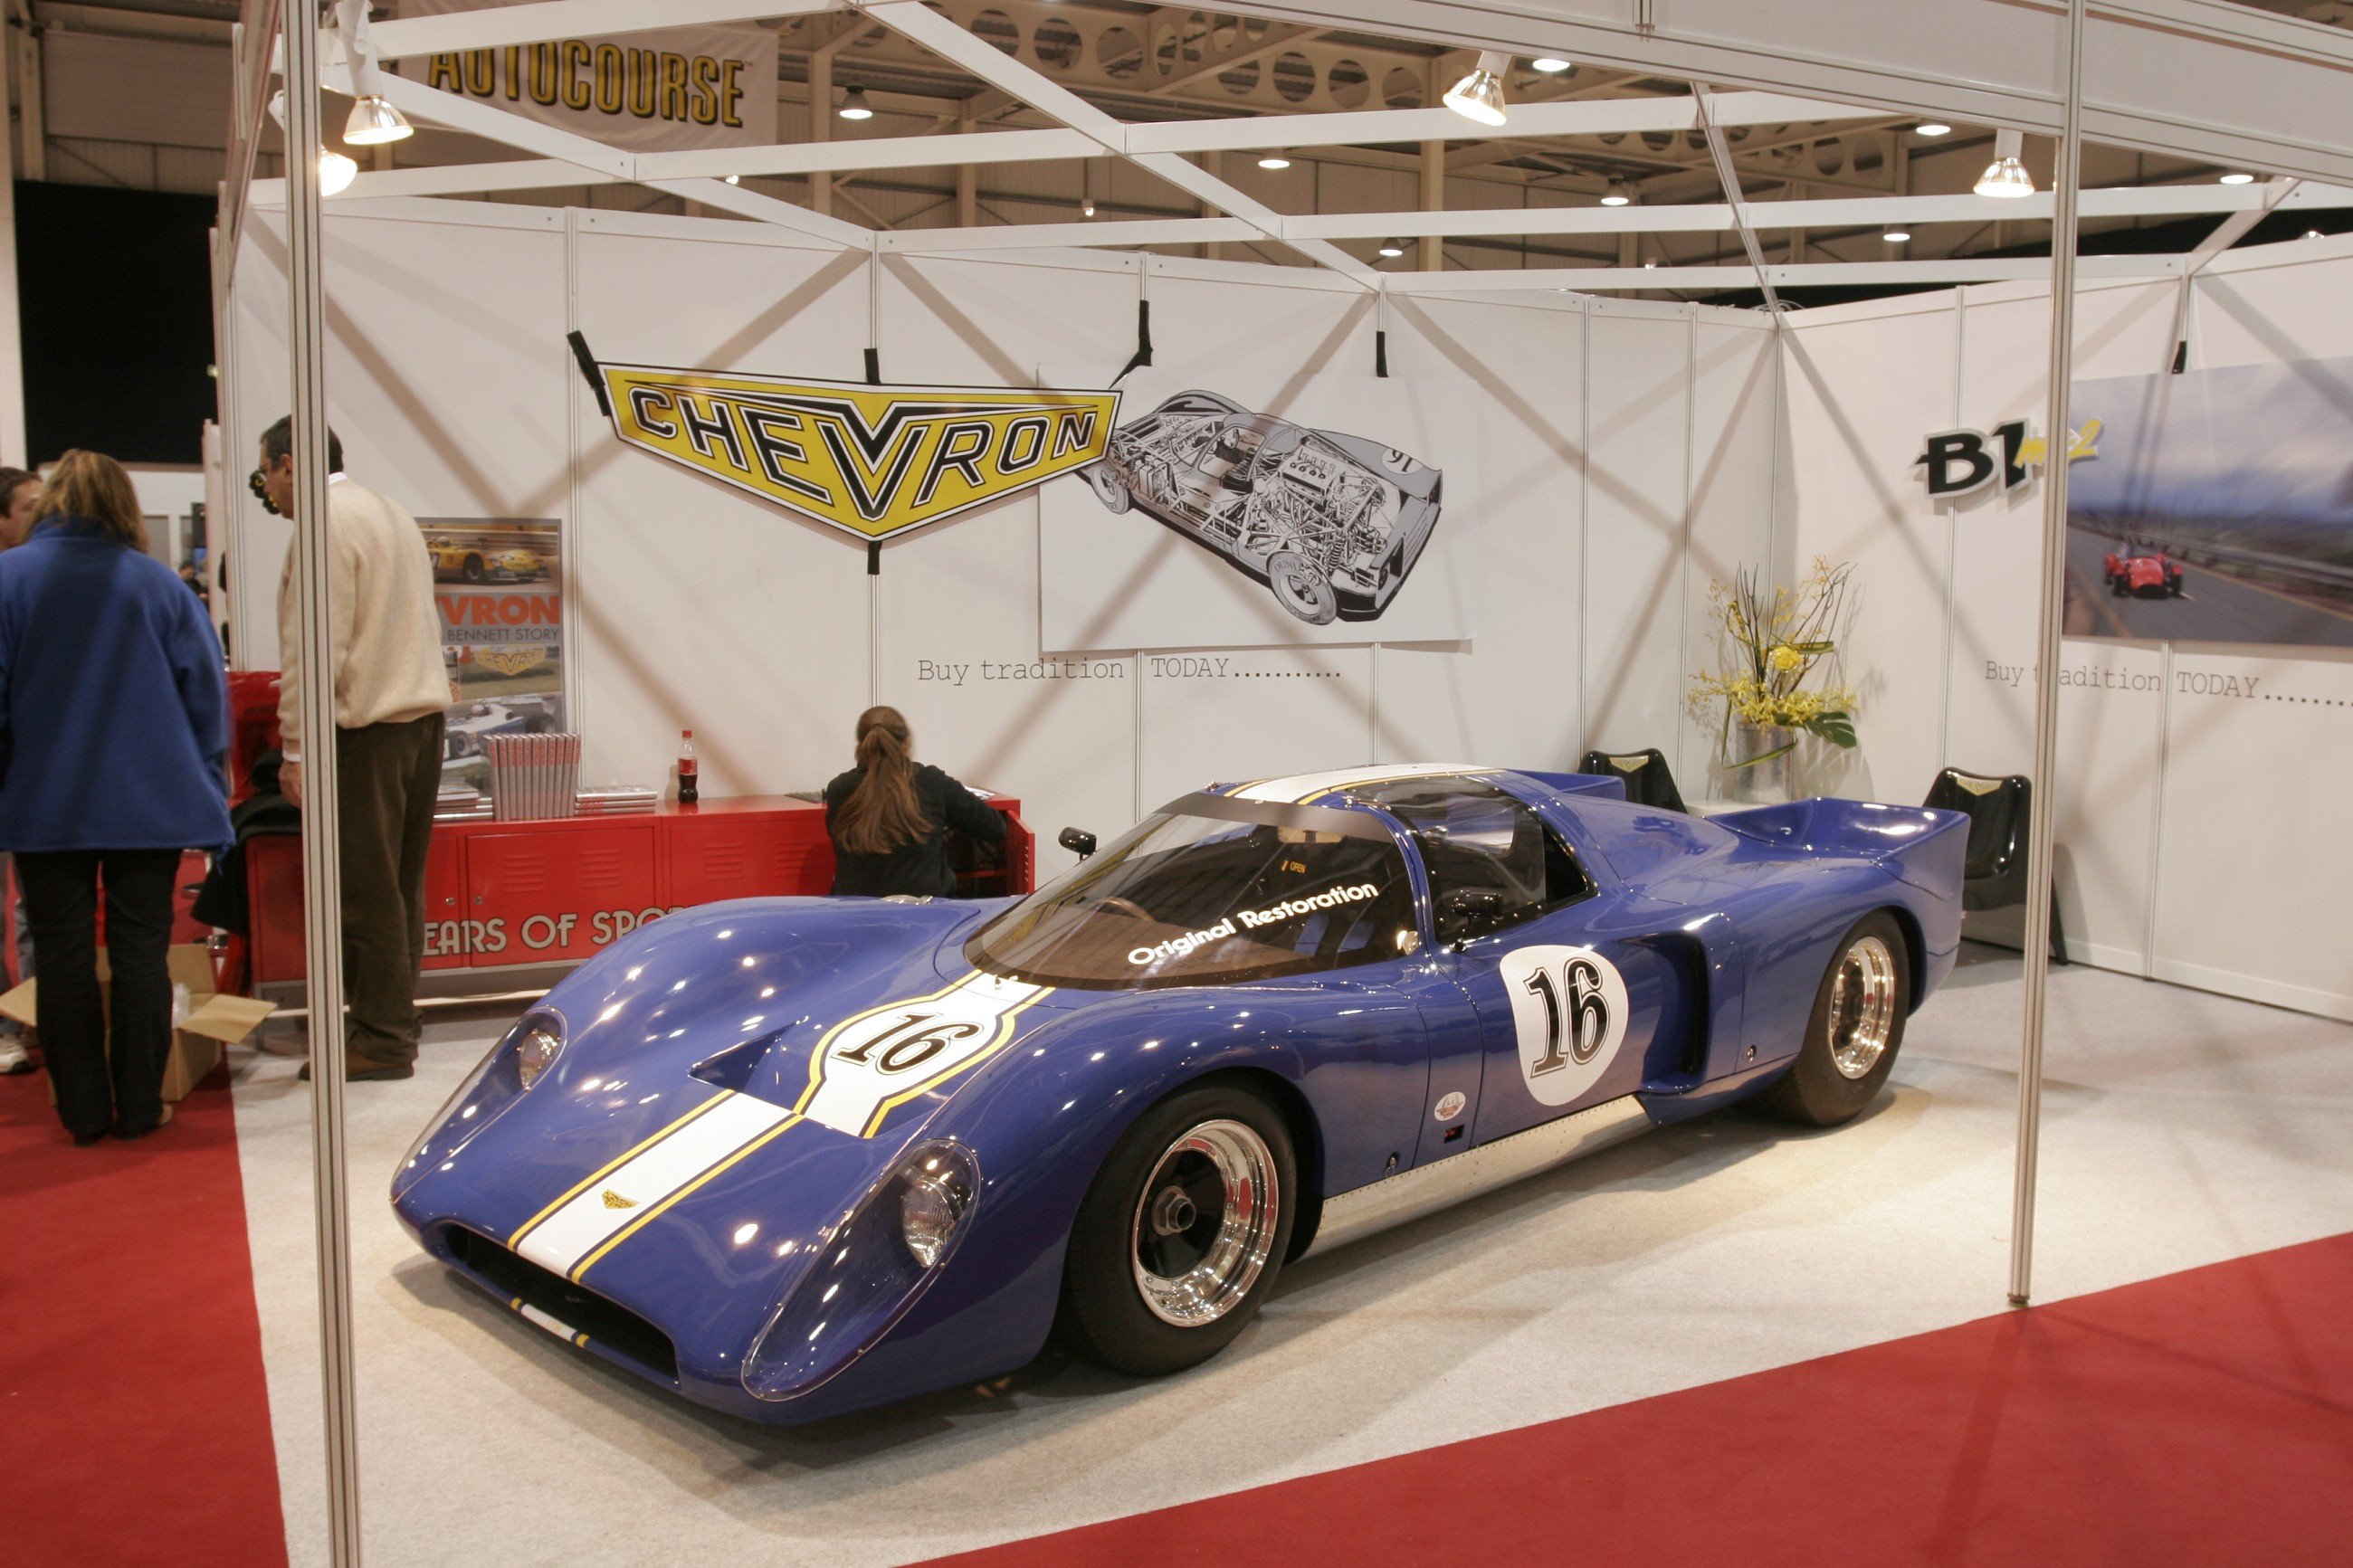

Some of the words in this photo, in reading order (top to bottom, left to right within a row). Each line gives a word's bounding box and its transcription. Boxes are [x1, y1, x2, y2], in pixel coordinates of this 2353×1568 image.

[428, 39, 745, 128] AUTOCOURSE
[626, 381, 1097, 522] CHEVRON
[435, 594, 561, 626] VRON
[447, 629, 511, 641] BENNETT
[515, 628, 559, 641] STORY
[918, 660, 969, 686] Buy
[981, 657, 1124, 679] tradition
[1986, 660, 2024, 688] Buy
[2033, 666, 2162, 691] tadition
[521, 912, 577, 949] OF
[591, 907, 686, 945] SPO
[1128, 917, 1237, 965] Original
[1236, 883, 1379, 929] Restoration
[830, 1012, 985, 1076] 16
[1523, 956, 1611, 1079] 16
